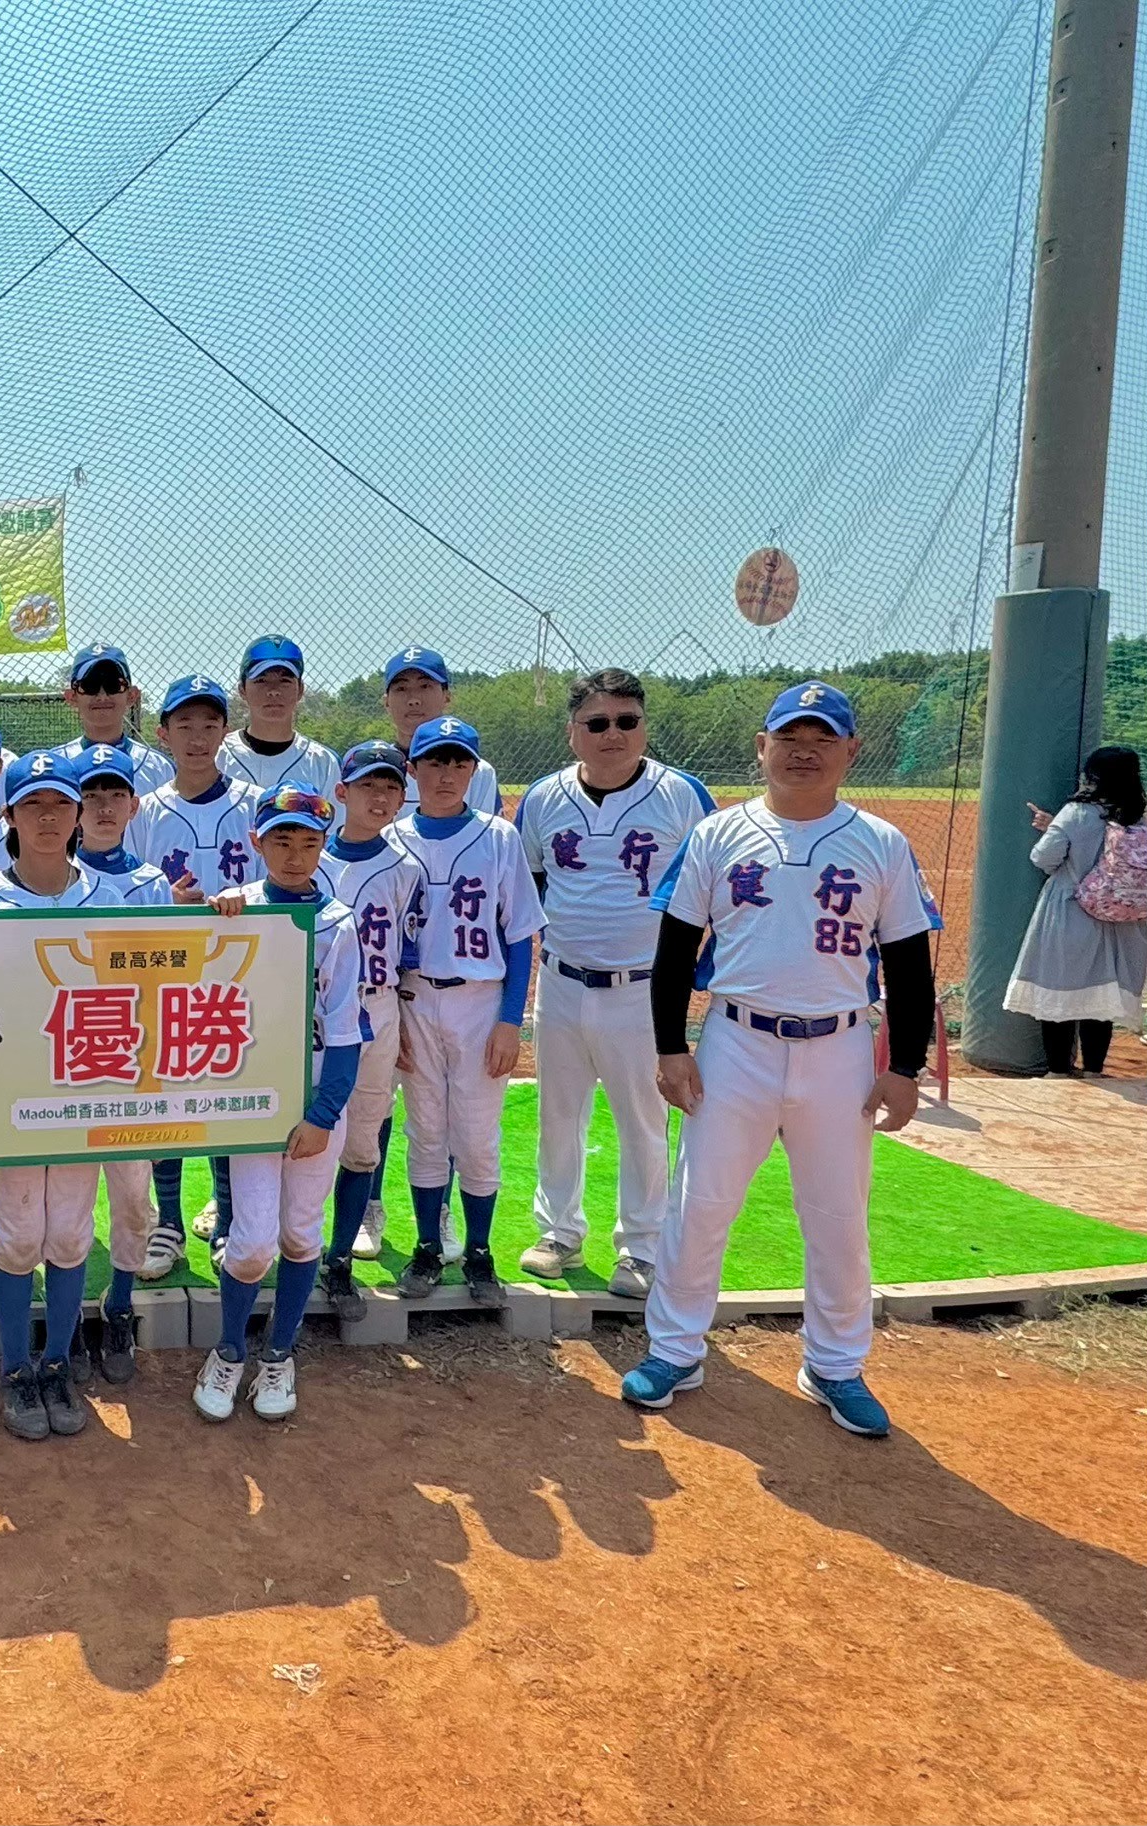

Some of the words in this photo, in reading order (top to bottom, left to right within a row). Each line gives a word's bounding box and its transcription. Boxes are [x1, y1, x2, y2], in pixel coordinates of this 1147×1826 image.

[449, 875, 487, 921] 行
[359, 902, 391, 951] 行
[454, 925, 489, 959] 19
[815, 918, 863, 957] 85
[108, 949, 188, 970] 最高榮譽
[45, 983, 250, 1083] 優勝
